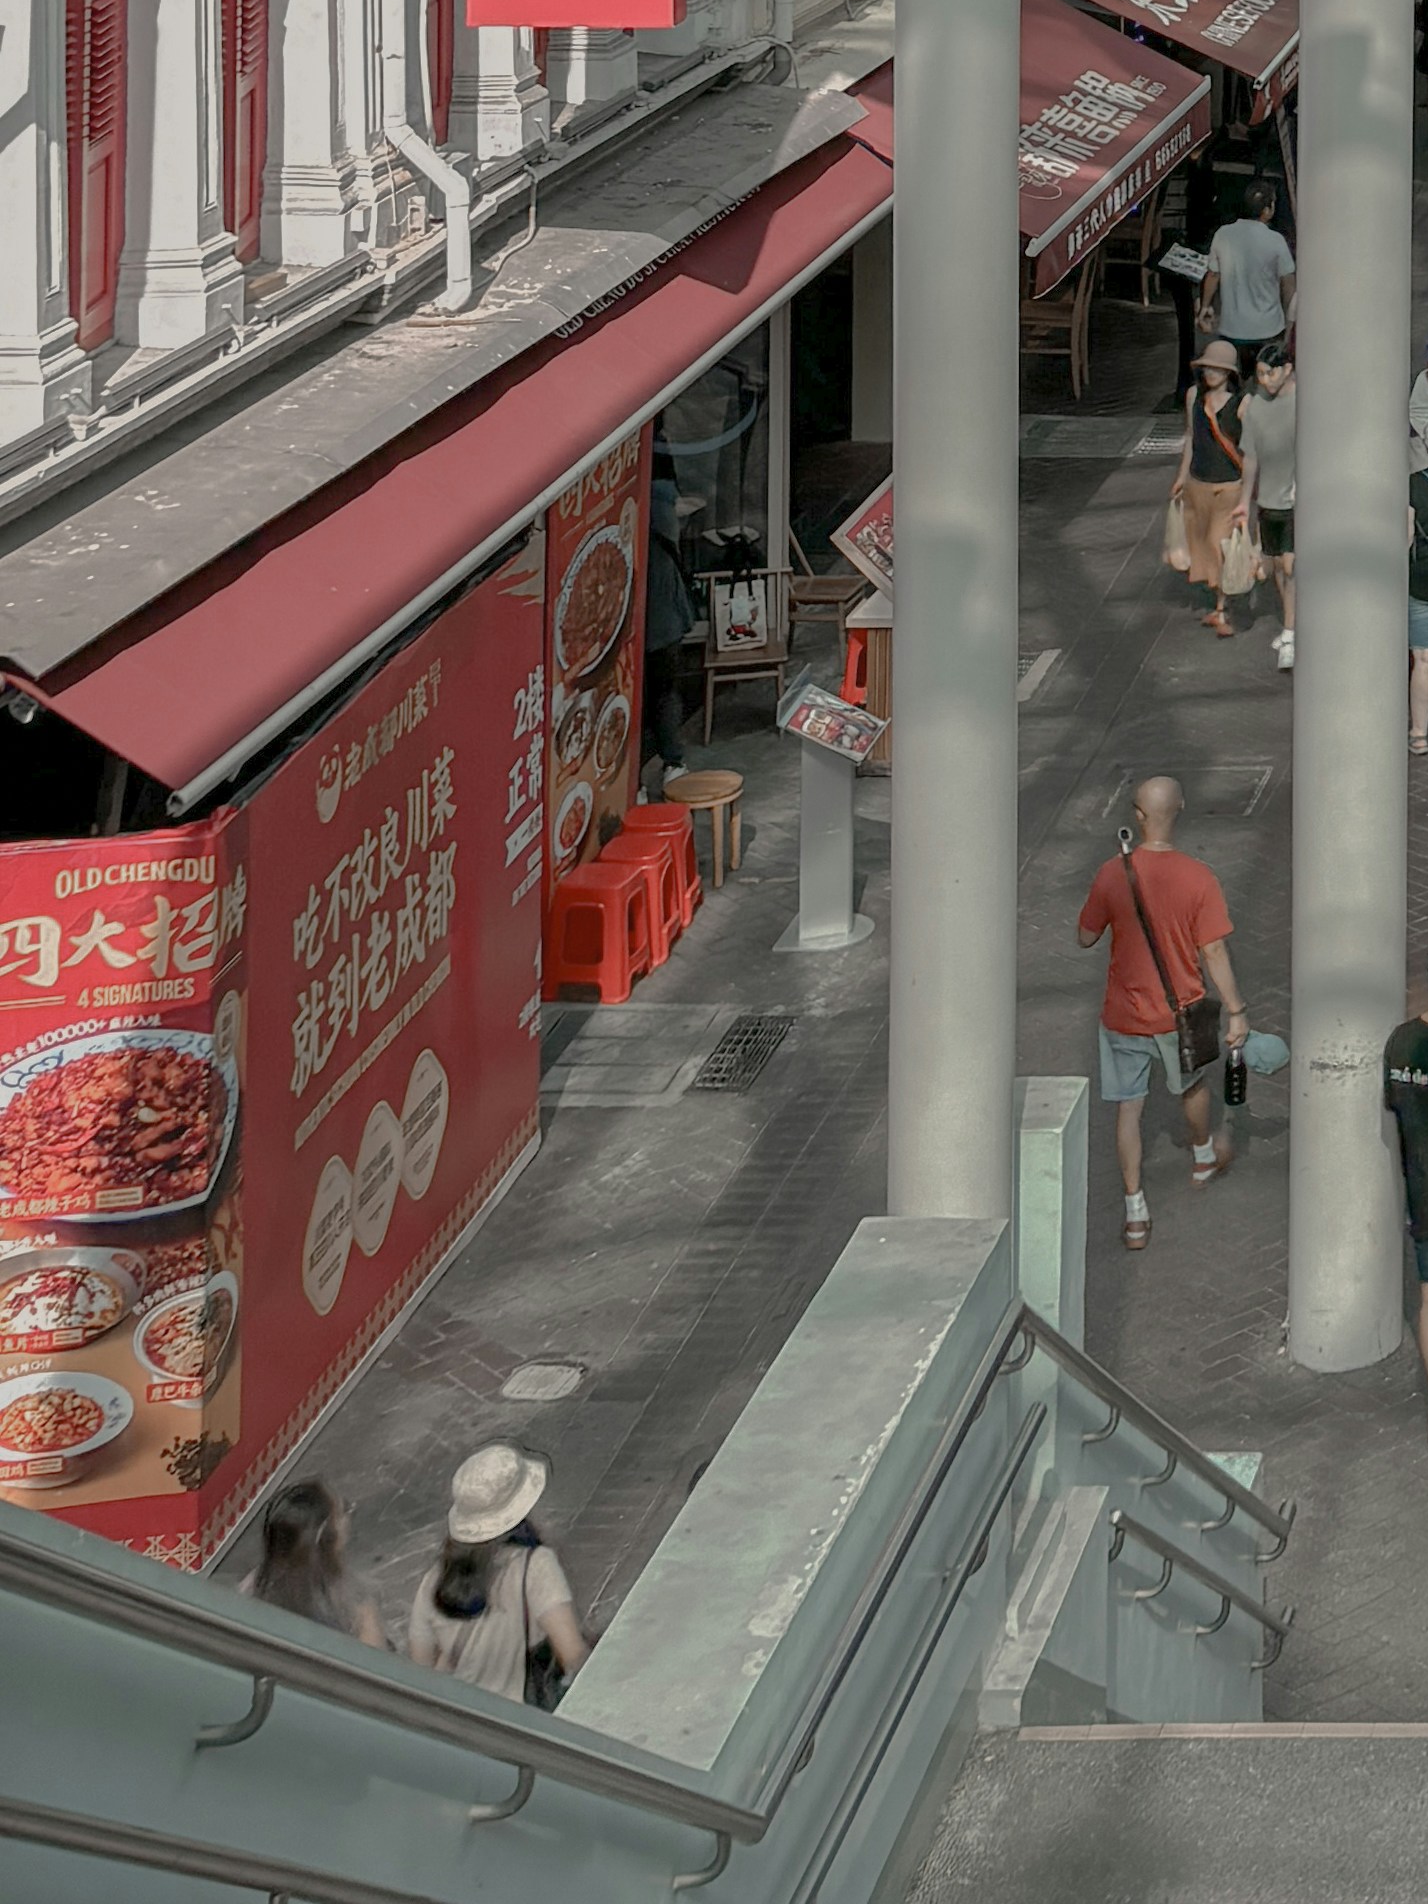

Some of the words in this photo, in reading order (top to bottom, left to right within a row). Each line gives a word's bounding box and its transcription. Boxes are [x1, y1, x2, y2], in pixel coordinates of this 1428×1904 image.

[290, 841, 458, 1099] 就到老成都
[292, 745, 458, 971] 吃不改良川菜
[77, 987, 89, 1009] 4
[92, 977, 195, 1008] SIGNATURES
